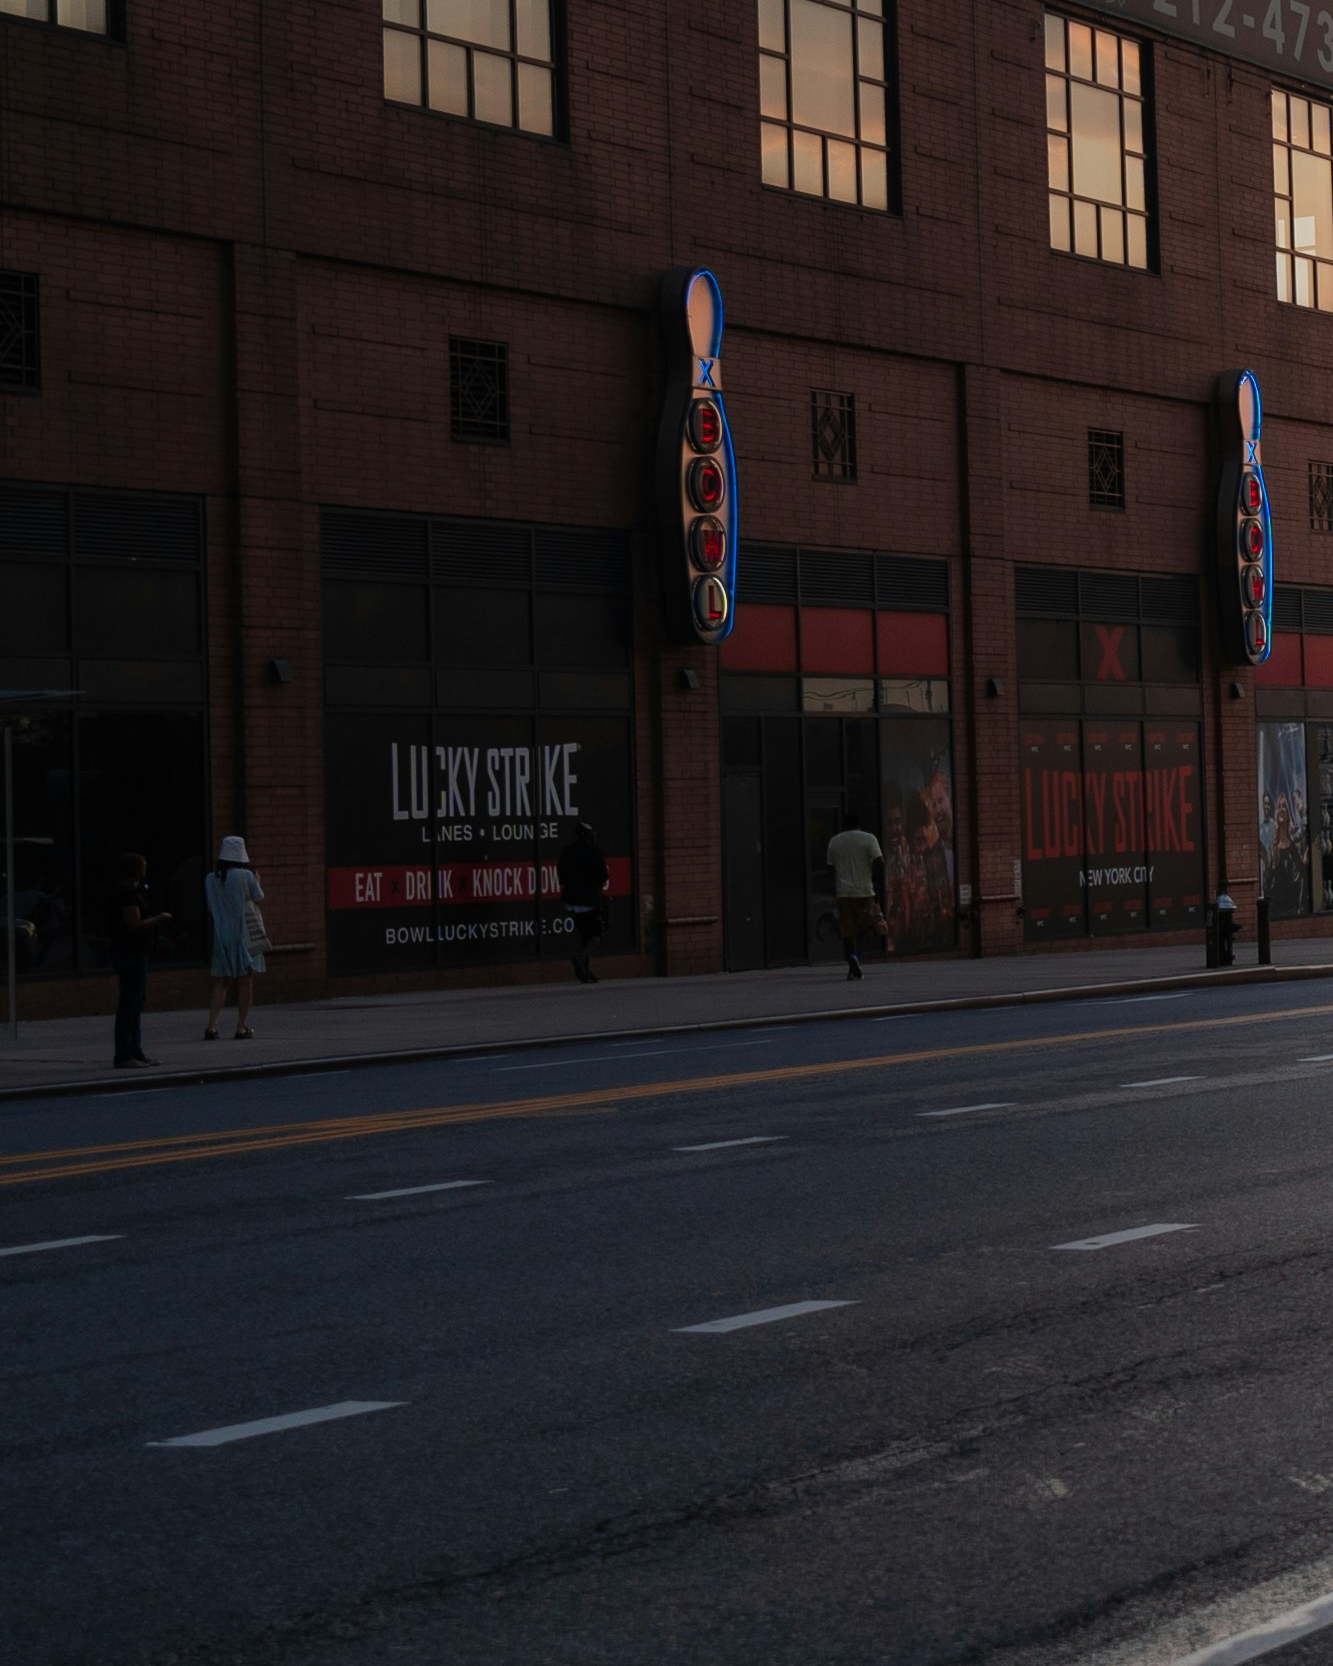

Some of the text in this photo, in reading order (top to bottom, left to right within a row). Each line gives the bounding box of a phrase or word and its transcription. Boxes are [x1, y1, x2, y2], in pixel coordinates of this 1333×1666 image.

[701, 407, 724, 620] BOWL
[1250, 480, 1266, 646] BOWL
[391, 742, 580, 821] LUCKY STRIKE
[492, 822, 559, 841] LOUNGE
[1024, 764, 1196, 861] LUCKY STRIKE
[354, 871, 383, 903] EAT
[405, 869, 454, 901] DRINK
[472, 866, 523, 898] KNOCK
[528, 865, 562, 895] DOW
[1079, 865, 1155, 888] NEW YORK CITY
[385, 917, 575, 945] BOWLLUCKYSTRIKE.CO
